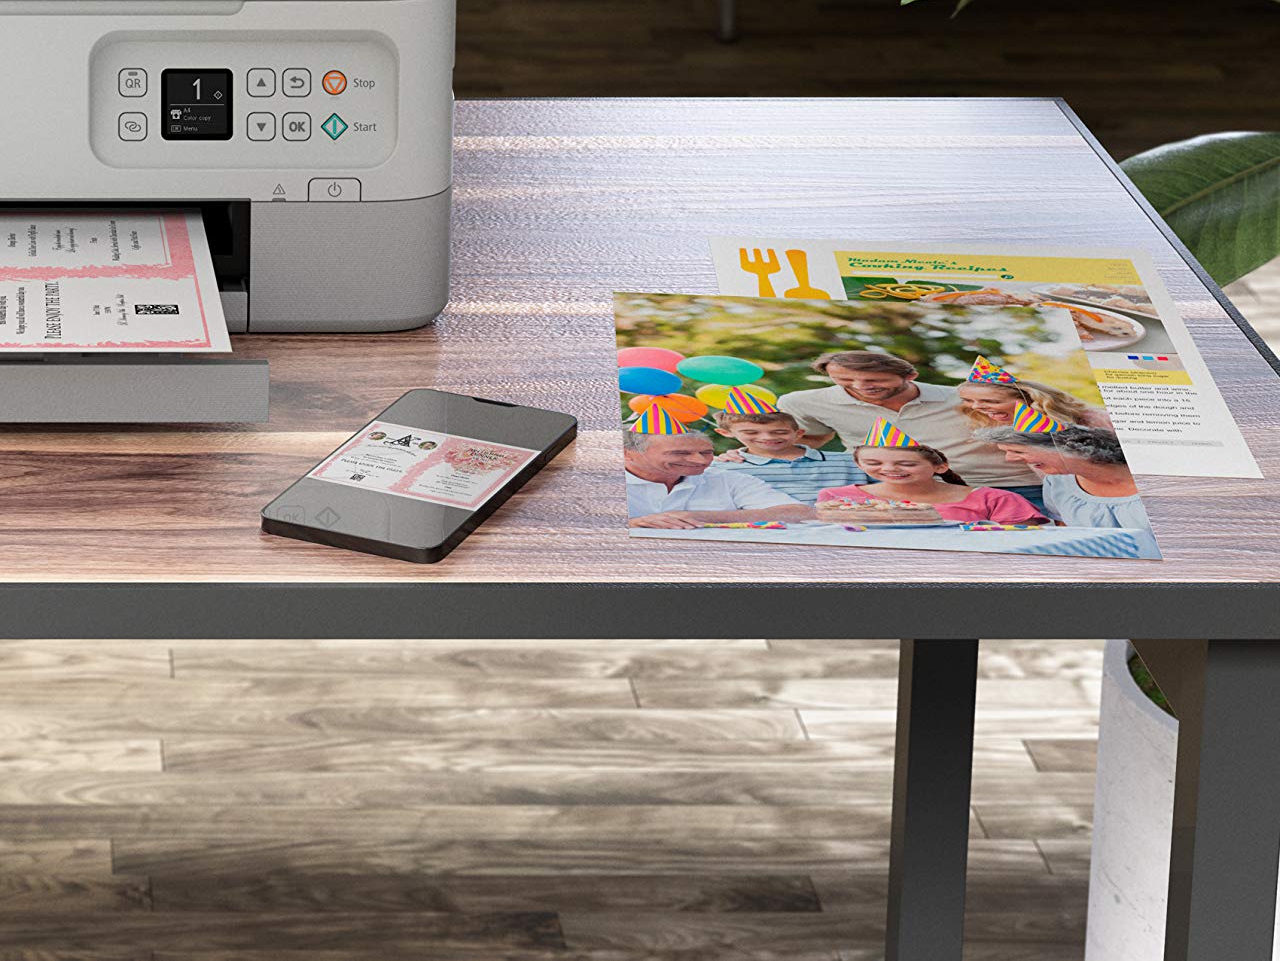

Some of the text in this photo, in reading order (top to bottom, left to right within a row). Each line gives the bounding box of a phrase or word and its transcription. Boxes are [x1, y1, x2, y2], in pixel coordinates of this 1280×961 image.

[125, 78, 141, 89] QR
[192, 78, 201, 100] 1
[353, 78, 375, 90] Stop
[289, 121, 306, 133] OK
[353, 122, 377, 132] Start
[849, 262, 1008, 273] Cooking Recipes
